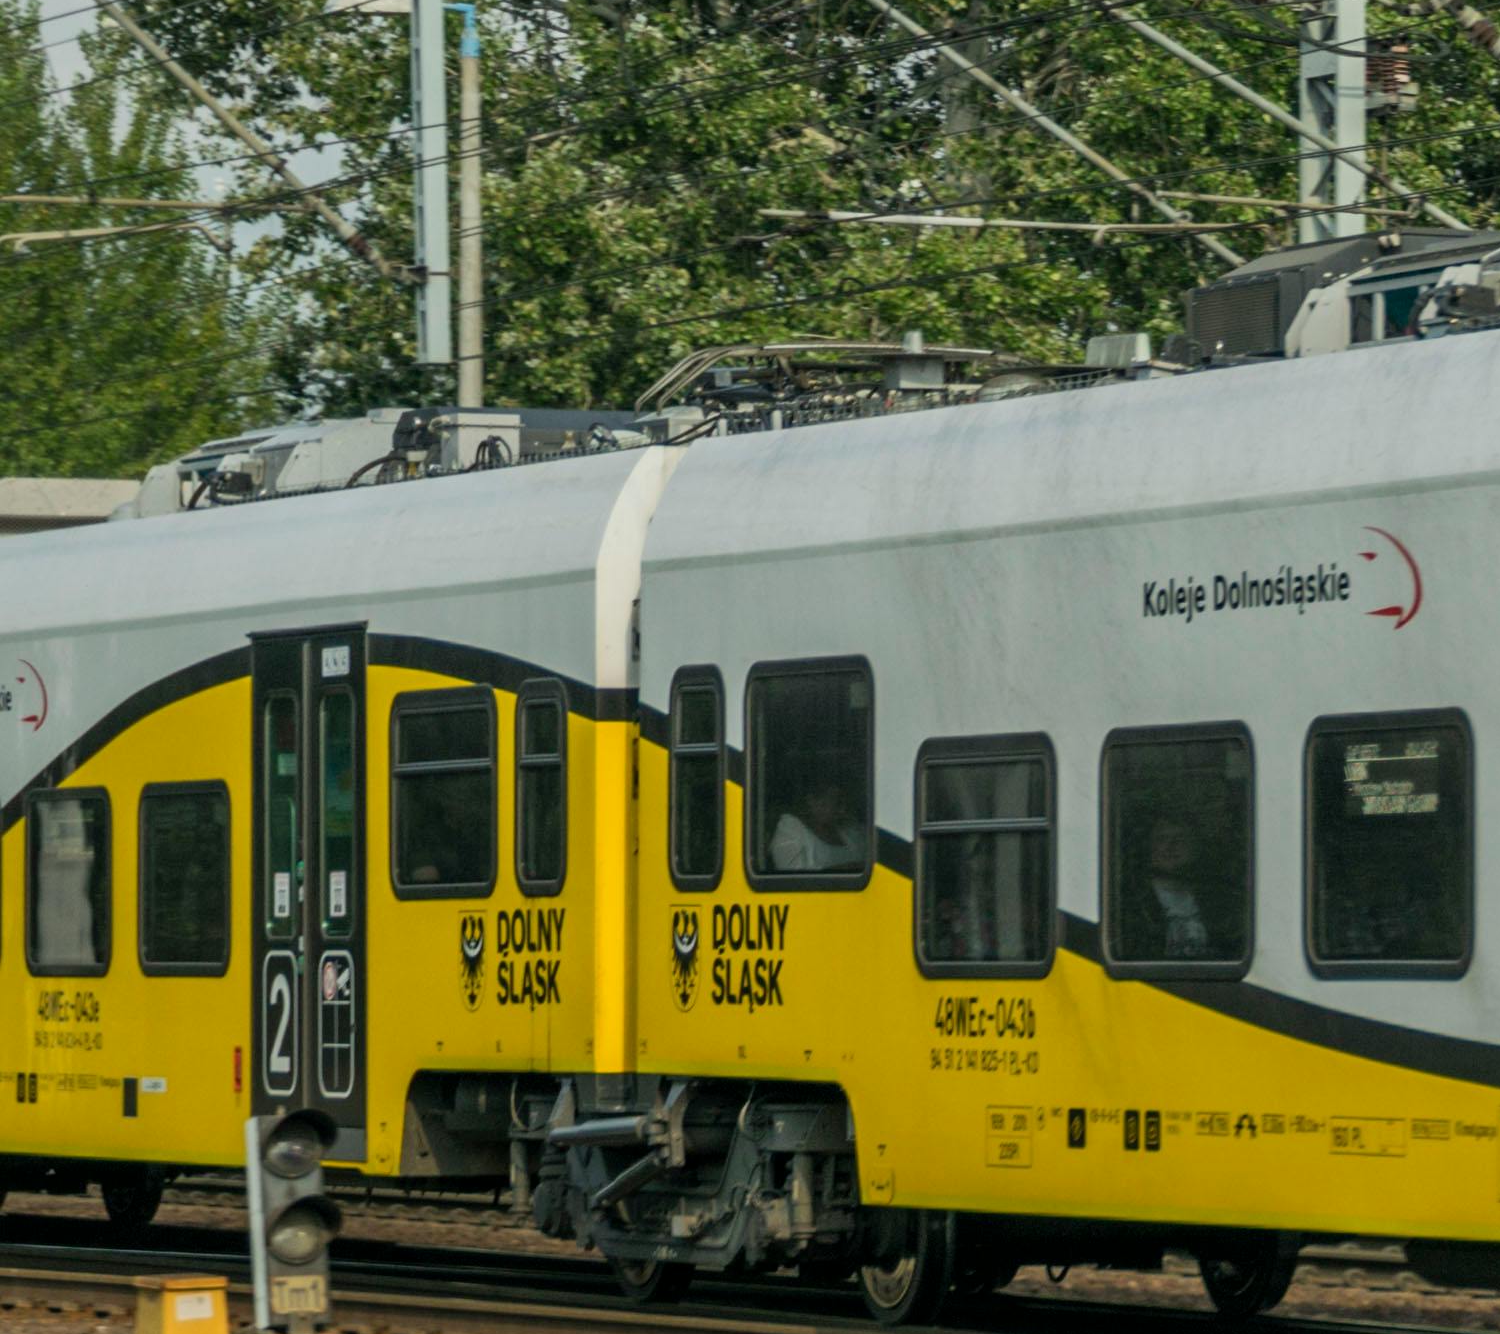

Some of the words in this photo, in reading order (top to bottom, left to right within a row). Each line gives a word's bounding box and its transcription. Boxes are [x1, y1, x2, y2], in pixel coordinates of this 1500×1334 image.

[1143, 576, 1206, 624] Koleje
[1213, 562, 1351, 616] Dolnośląskie
[496, 907, 566, 954] DOLNY
[711, 903, 790, 951] DOLNY
[496, 950, 562, 1012] ŚLĄSK
[711, 947, 785, 1014] ŚLĄSK
[269, 973, 291, 1074] 2
[934, 995, 1037, 1039] 48WEc-043b
